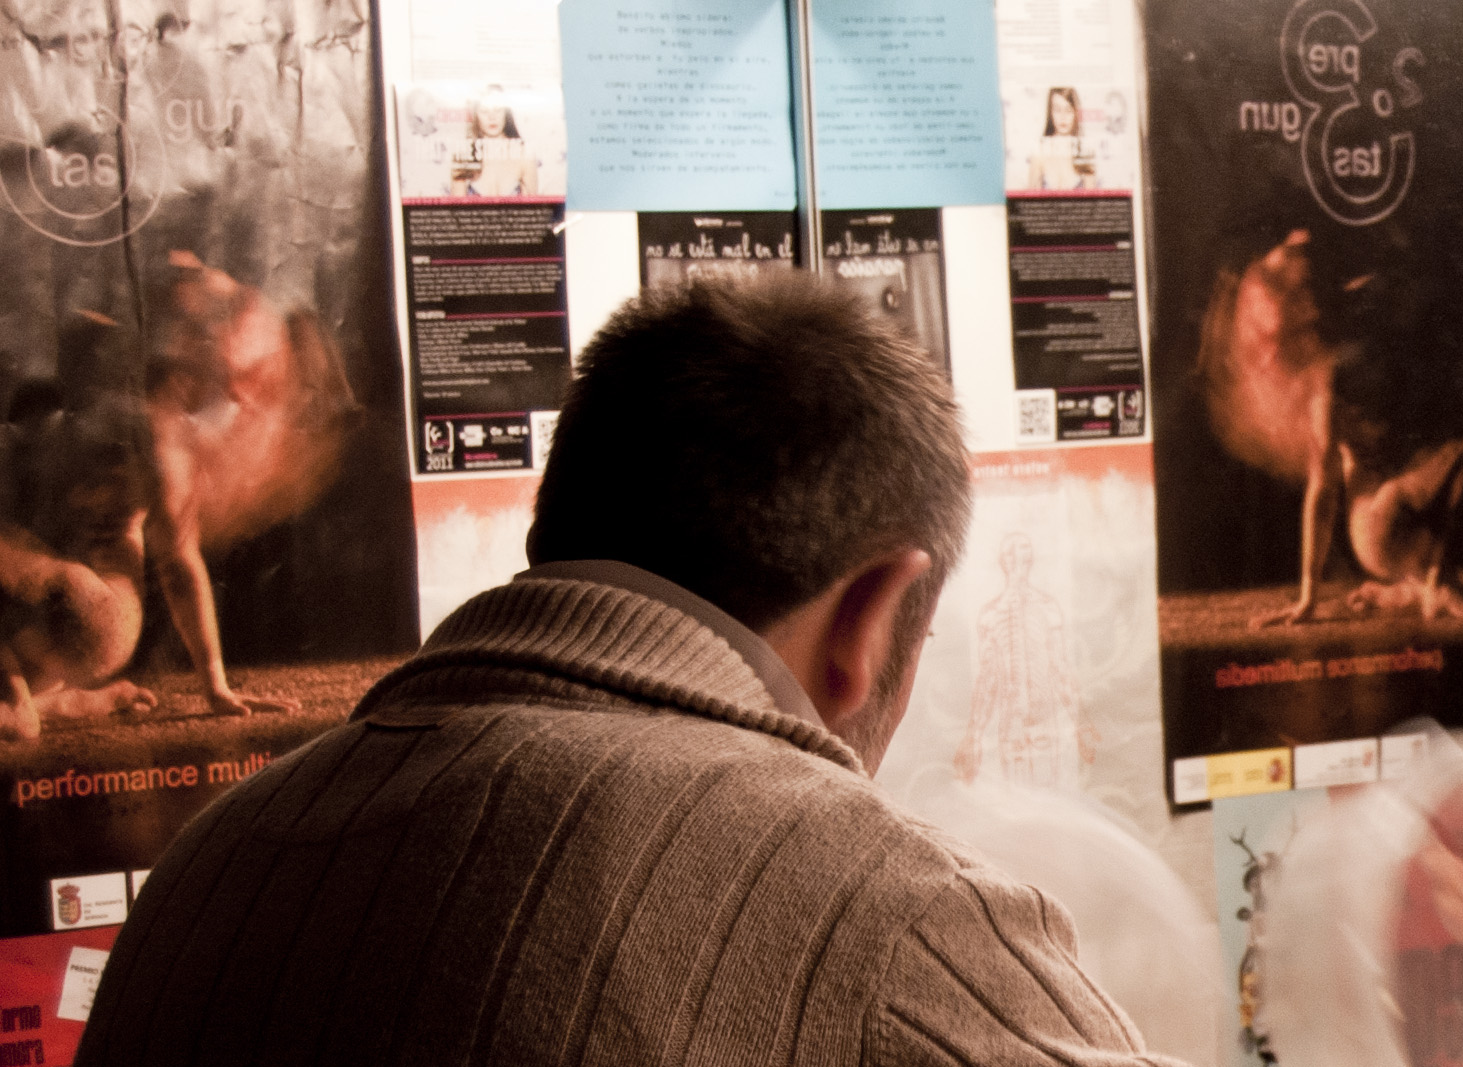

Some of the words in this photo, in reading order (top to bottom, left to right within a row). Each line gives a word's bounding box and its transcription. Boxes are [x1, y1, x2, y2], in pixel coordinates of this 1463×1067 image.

[46, 147, 120, 189] tas
[426, 453, 454, 471] 2011
[16, 763, 199, 808] performance
